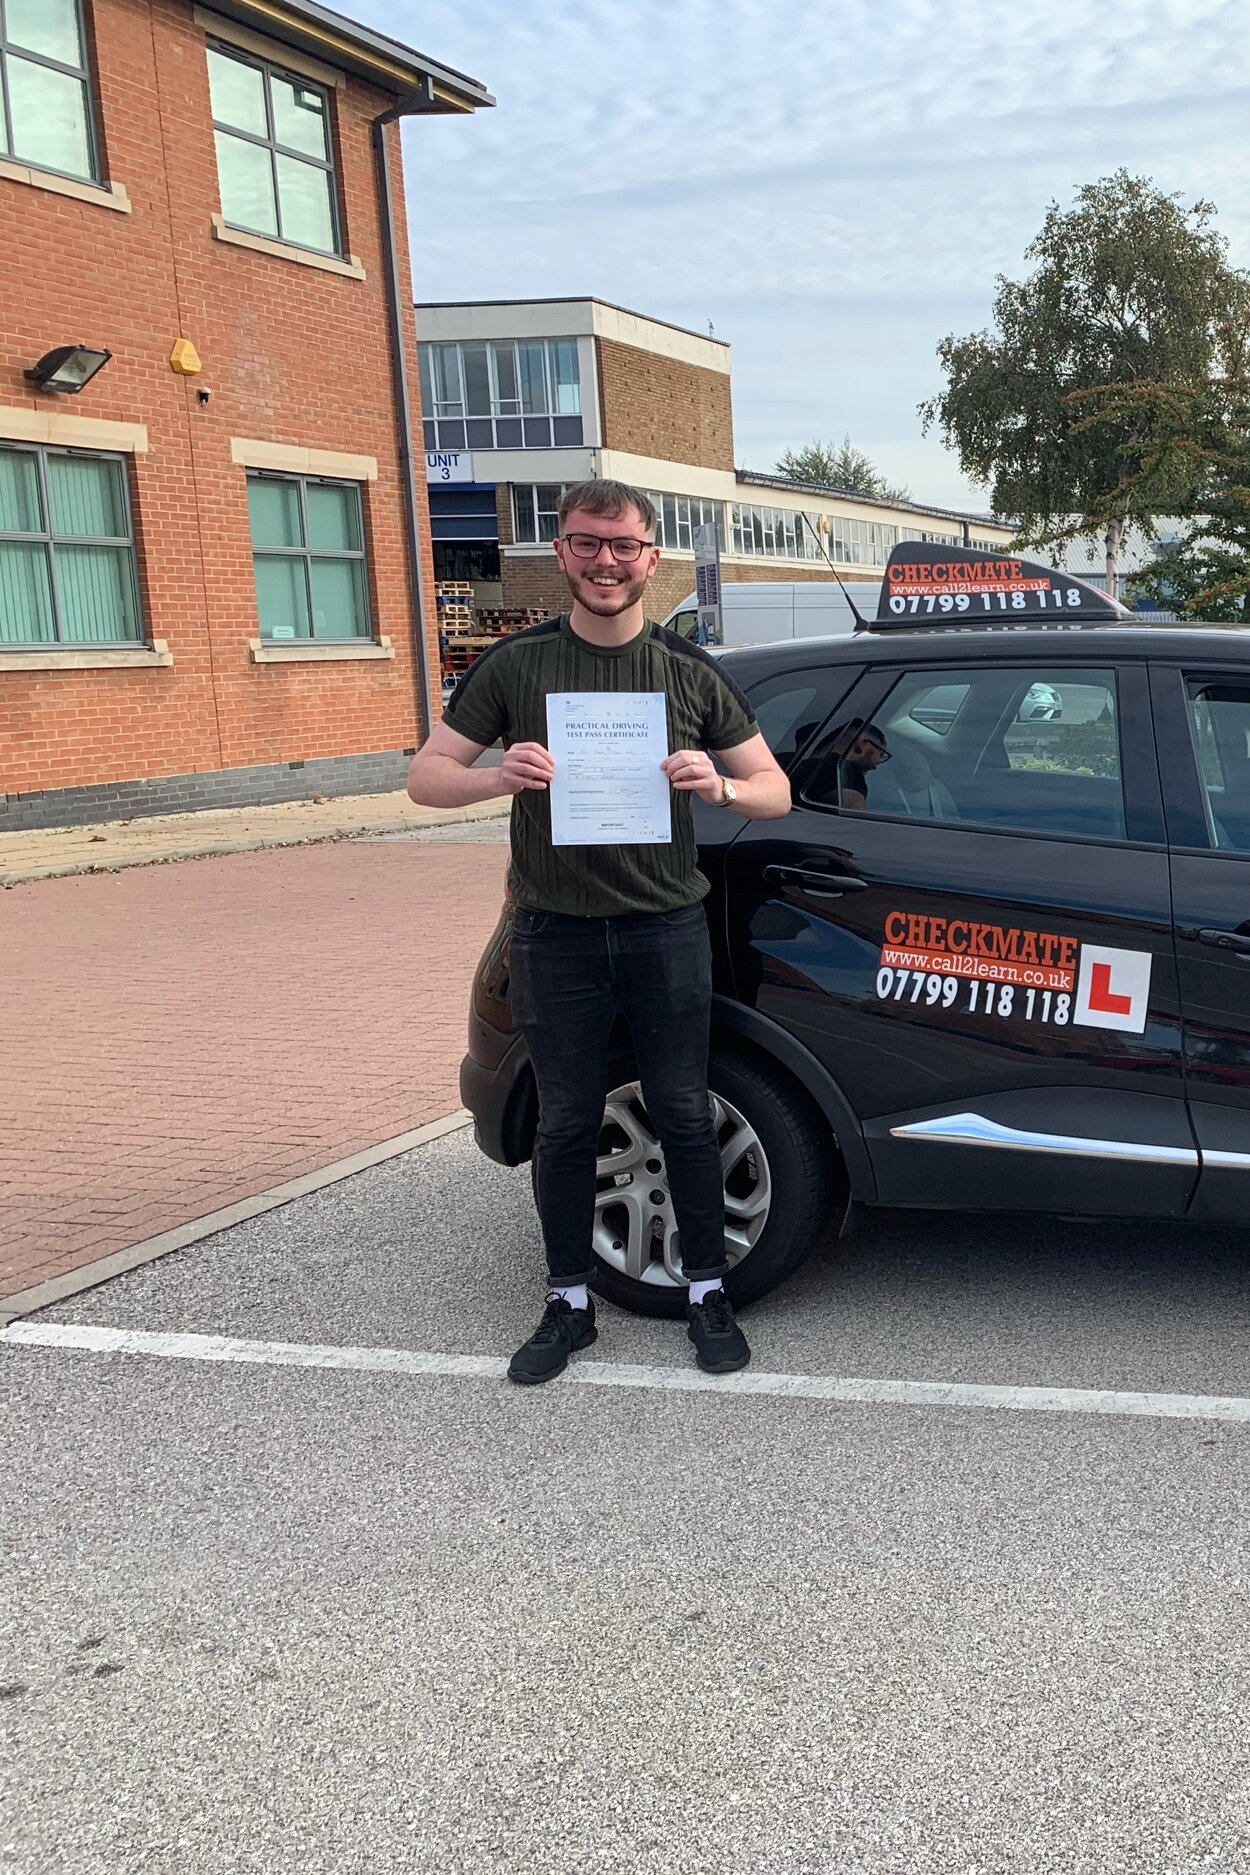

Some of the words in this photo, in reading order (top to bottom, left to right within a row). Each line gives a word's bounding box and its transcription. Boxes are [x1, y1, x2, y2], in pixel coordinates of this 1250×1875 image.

[427, 454, 460, 467] UNIT
[441, 468, 450, 480] 3
[888, 561, 1024, 583] CHECKMATE
[892, 580, 1050, 594] www.call2learn.co.uk
[889, 594, 970, 614] 07799
[981, 592, 1027, 611] 118
[1036, 588, 1081, 608] 118
[884, 911, 1078, 970] CHECKMATE
[884, 950, 1071, 989] www.call2learn.co.uk
[876, 967, 958, 1008] 07799
[969, 980, 1015, 1017] 118
[1025, 989, 1071, 1026] 118
[1088, 962, 1132, 1015] L
